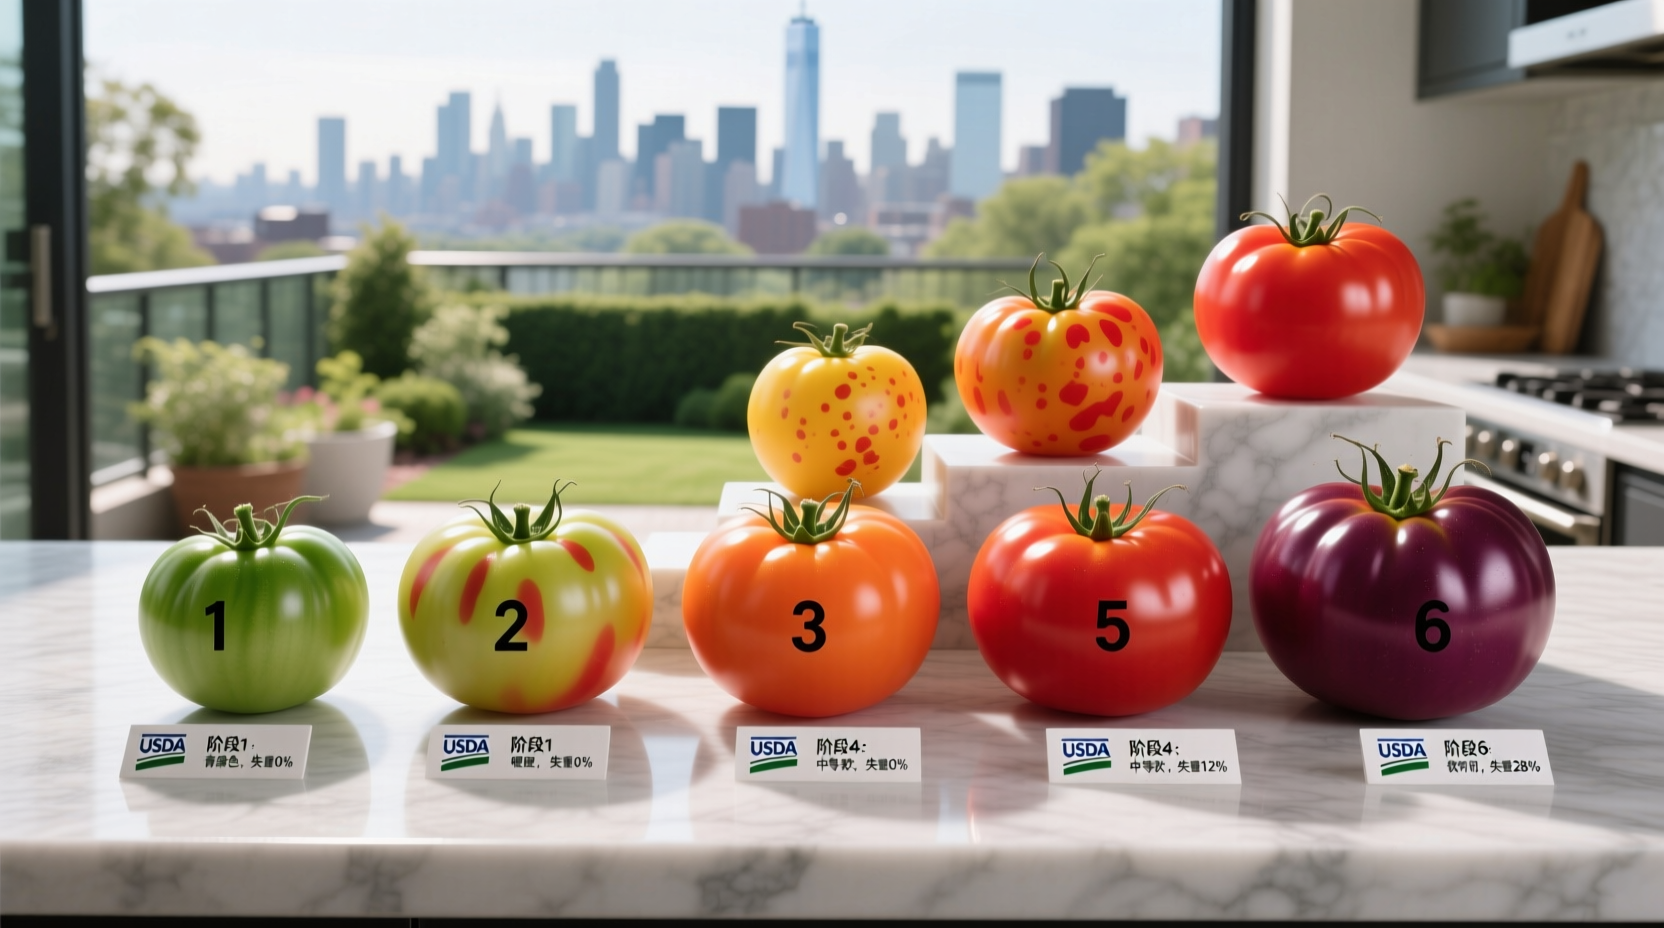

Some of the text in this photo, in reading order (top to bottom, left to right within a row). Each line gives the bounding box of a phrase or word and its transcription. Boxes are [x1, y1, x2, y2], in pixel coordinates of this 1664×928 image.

[205, 600, 225, 651] 1
[494, 599, 528, 652] 2
[792, 600, 826, 653] 3
[1095, 600, 1130, 652] 5
[1415, 599, 1451, 653] 6
[139, 737, 186, 754] USDA
[443, 738, 490, 755] USDA
[510, 735, 552, 754] 阶段1
[750, 740, 798, 757] USDA
[1062, 741, 1111, 758] USDA
[1377, 742, 1427, 758] USDA
